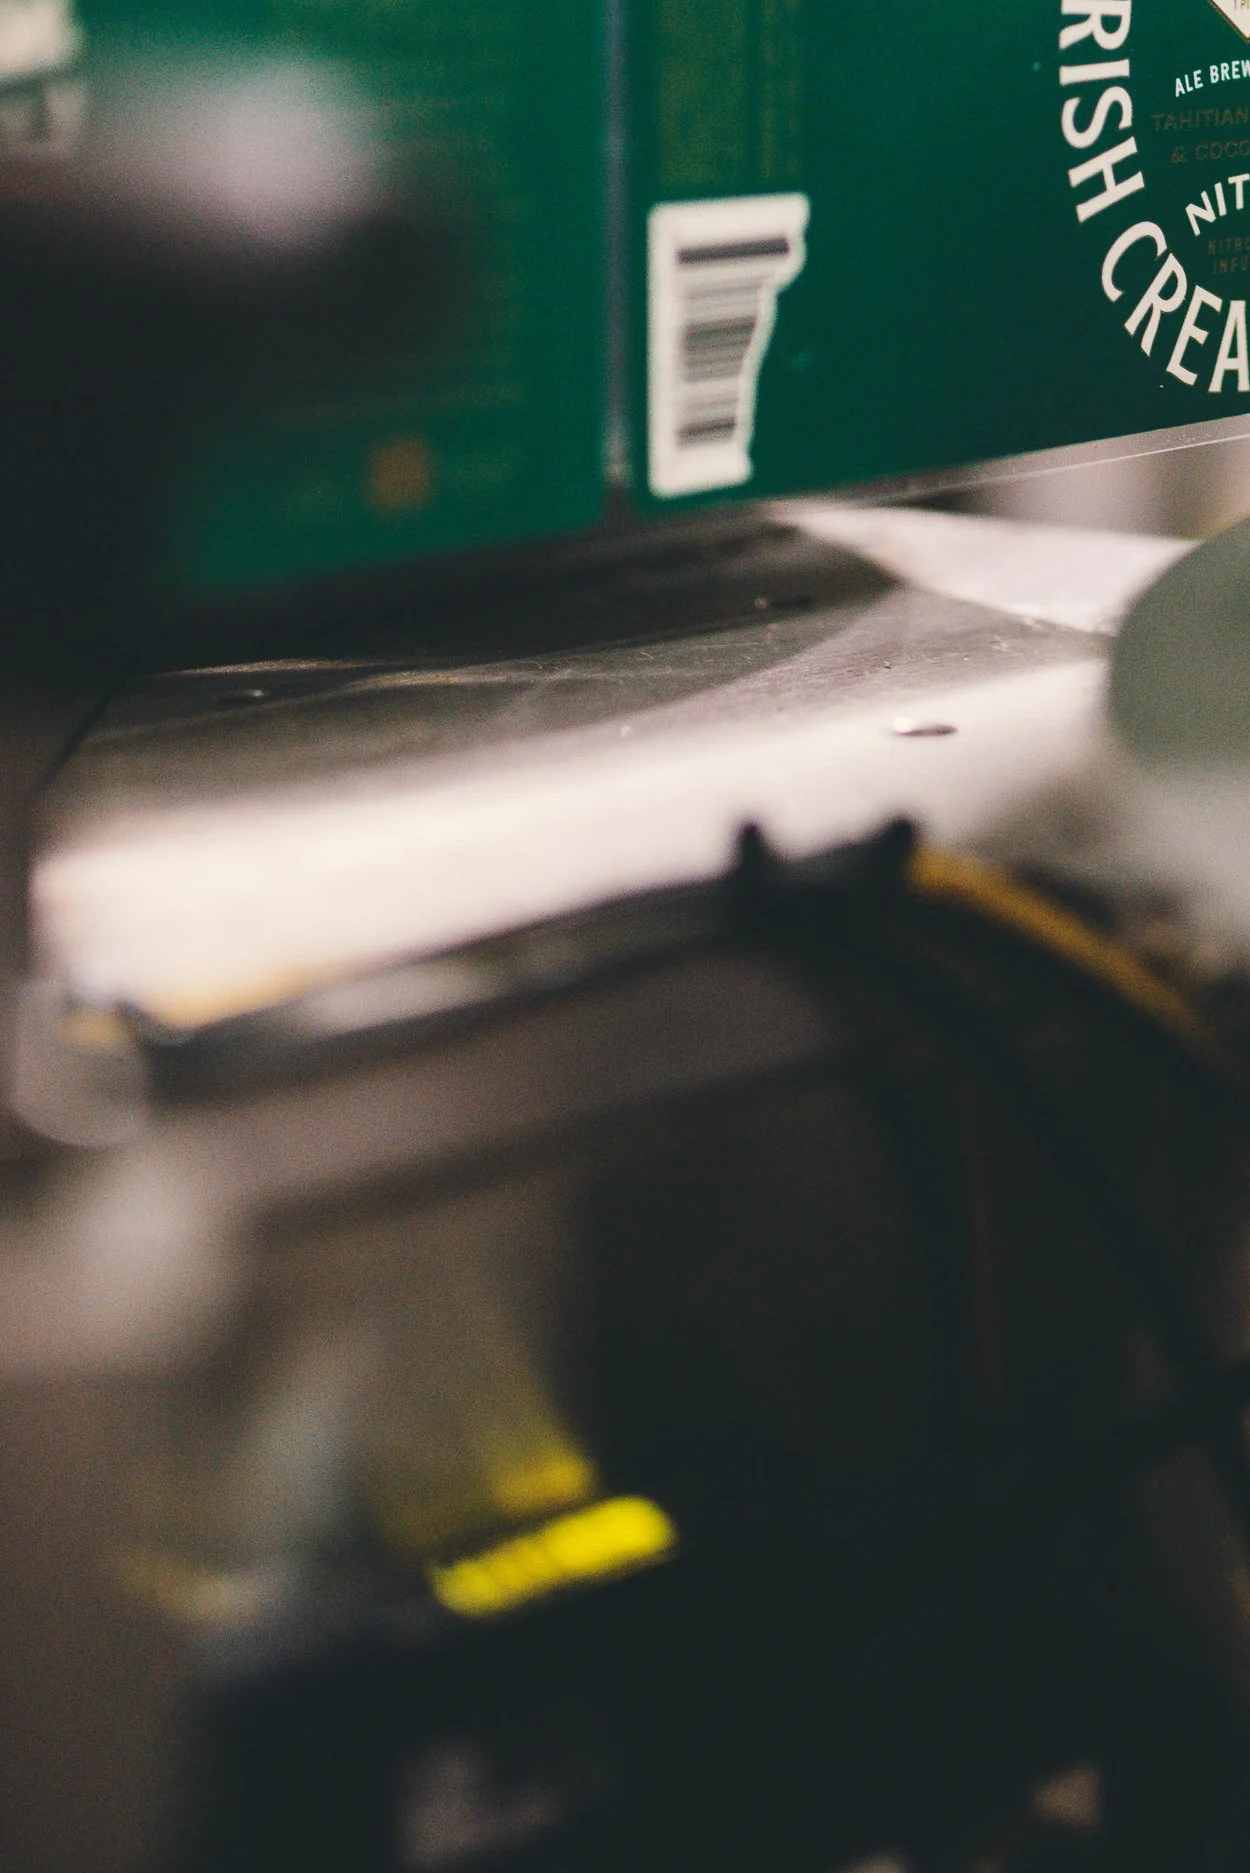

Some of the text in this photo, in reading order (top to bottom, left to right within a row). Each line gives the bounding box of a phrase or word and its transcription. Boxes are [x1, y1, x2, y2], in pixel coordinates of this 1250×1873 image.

[1233, 0, 1238, 11] 1
[1174, 69, 1203, 97] ALE
[1151, 105, 1250, 132] TAHITIAN
[1170, 146, 1187, 163] &
